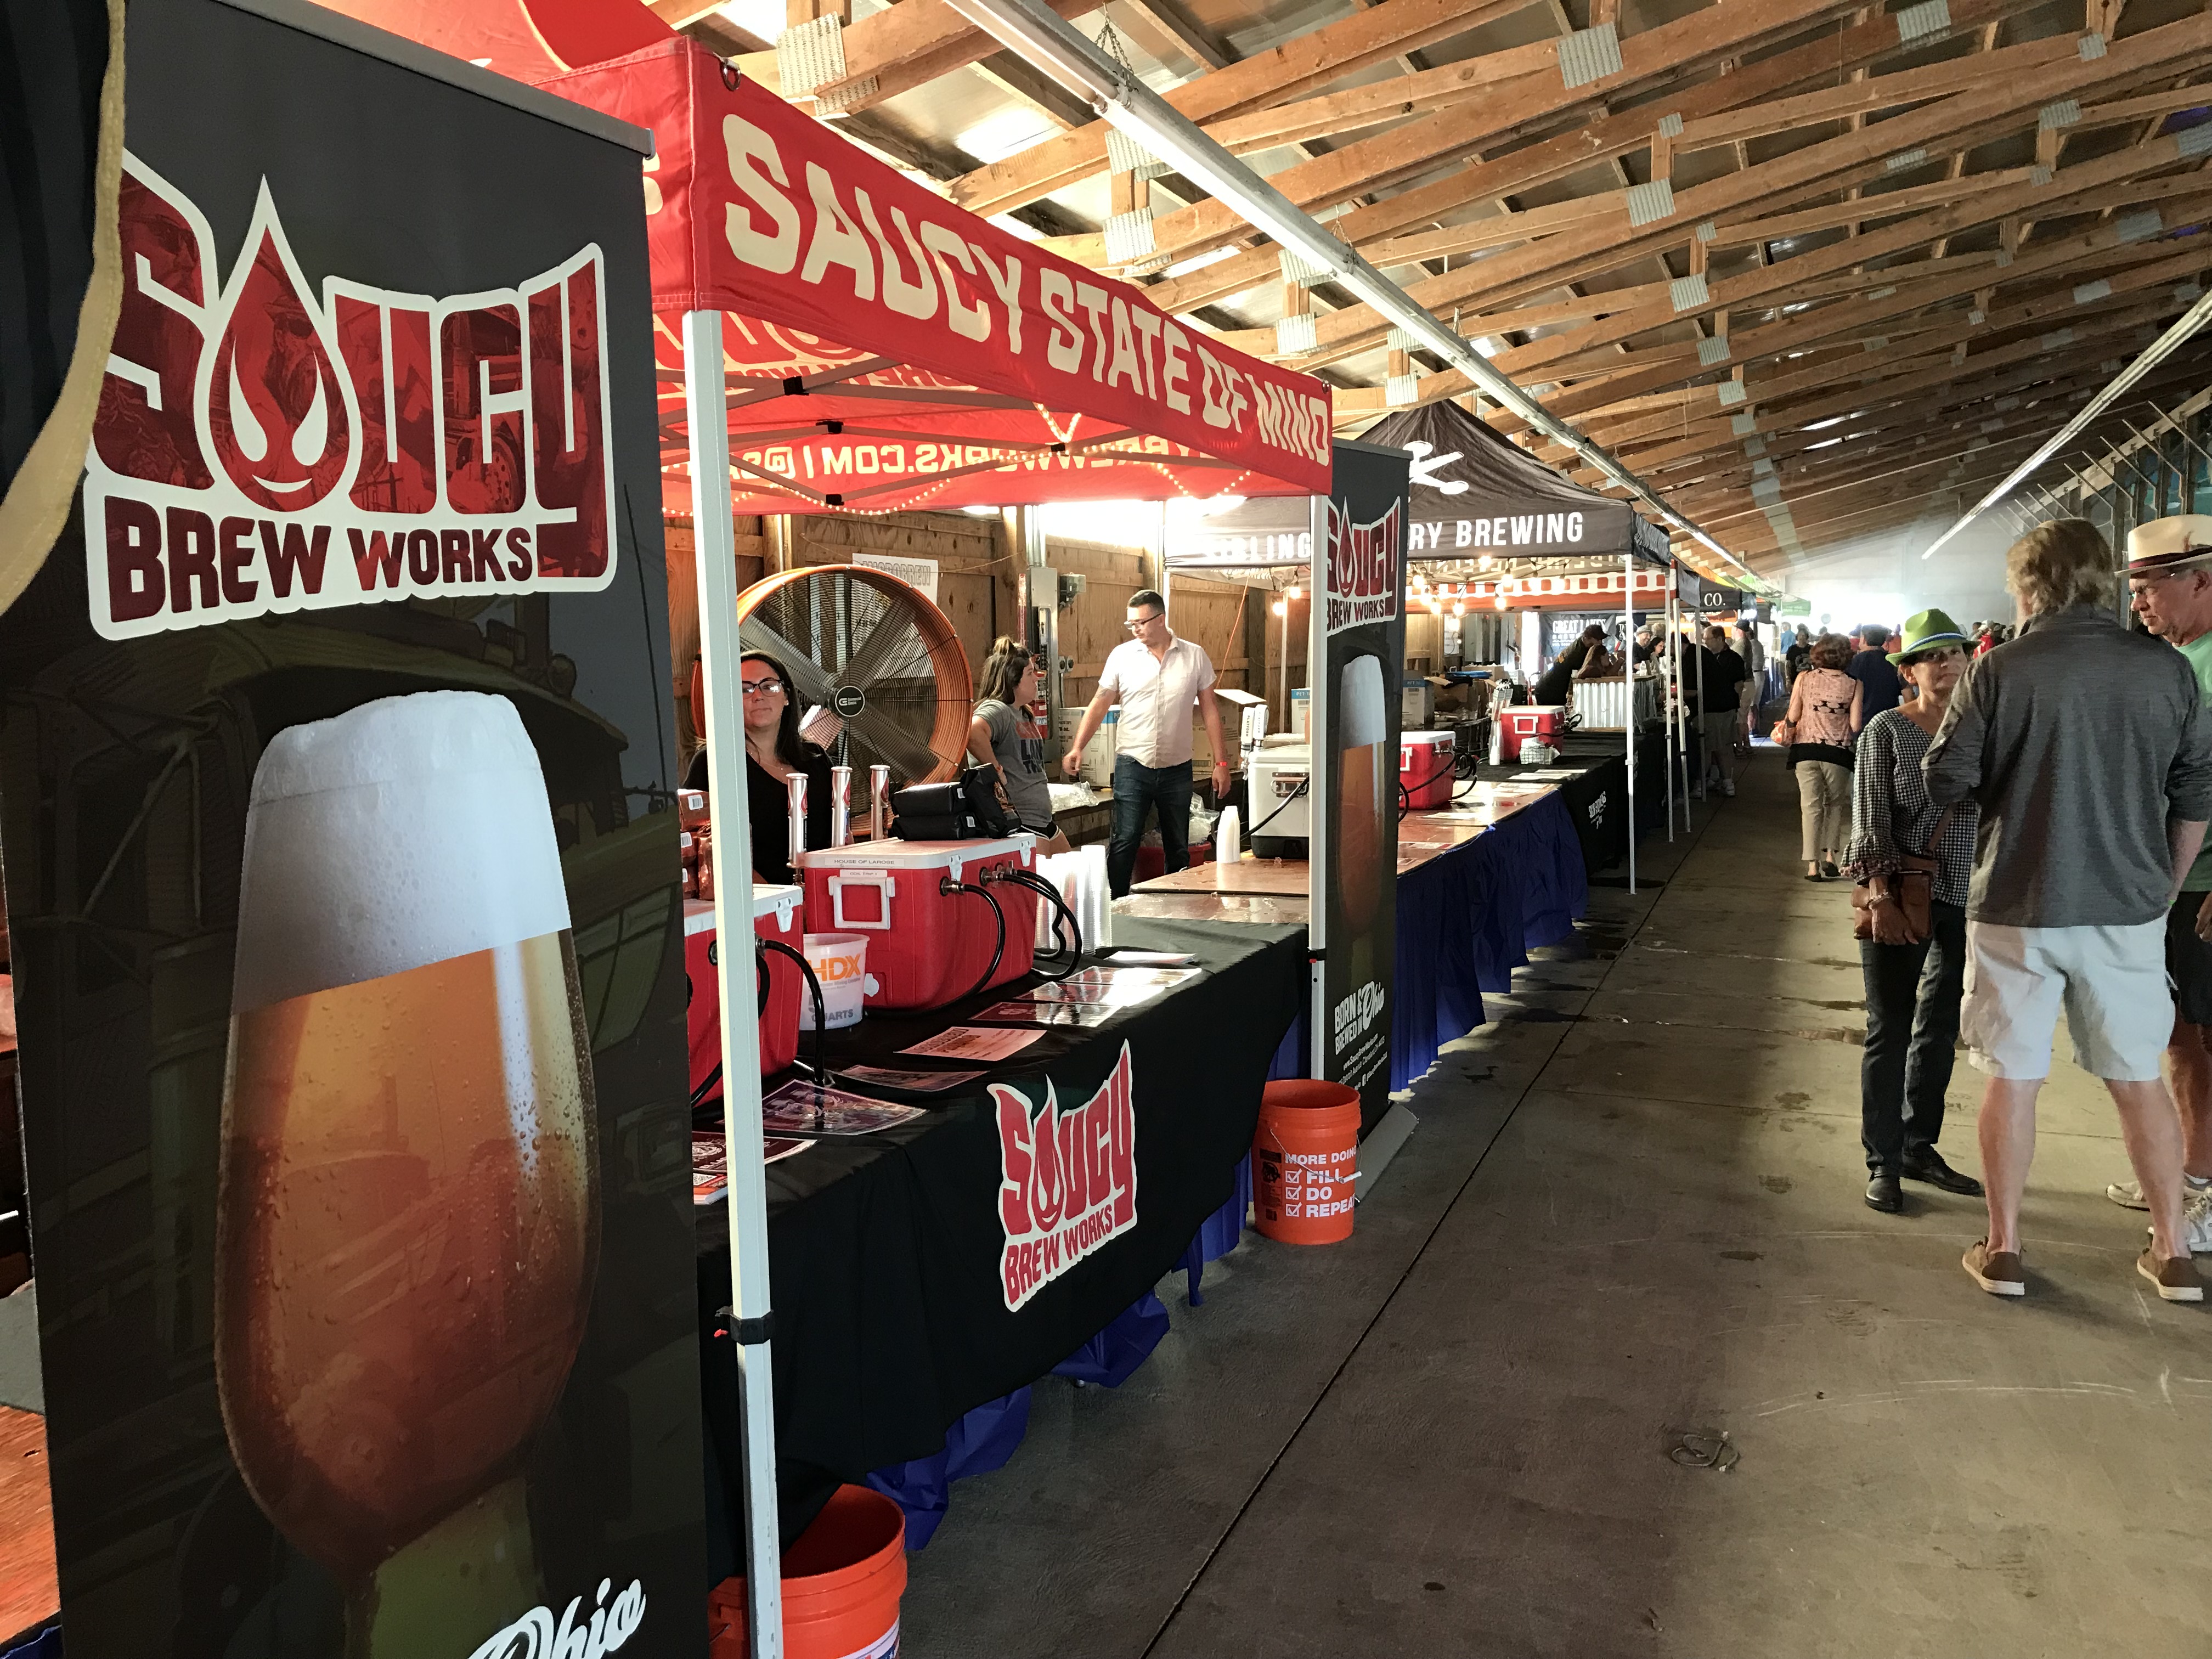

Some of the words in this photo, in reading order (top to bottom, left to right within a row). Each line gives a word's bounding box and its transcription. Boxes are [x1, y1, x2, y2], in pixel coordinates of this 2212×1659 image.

[723, 113, 1023, 355] SAUCY
[1040, 267, 1191, 415] STATE
[1196, 343, 1248, 433] OF
[1245, 372, 1330, 466] MIND
[1455, 511, 1584, 548] BREWING
[104, 494, 331, 623] BREW
[347, 524, 533, 592] WORKS
[1353, 598, 1384, 623] WORKS
[1703, 592, 1726, 606] CO.
[1552, 619, 1578, 634] GREAT
[807, 953, 861, 982] HDX
[1334, 992, 1356, 1034] BORN
[1357, 988, 1362, 1016] &
[1335, 1020, 1357, 1056] BREWED
[1357, 1014, 1363, 1036] IN
[1285, 1153, 1327, 1165] MORE
[1306, 1168, 1343, 1184] FILL
[1306, 1186, 1333, 1201] DO
[1004, 1231, 1061, 1306] BREW
[1063, 1204, 1113, 1261] WORKS
